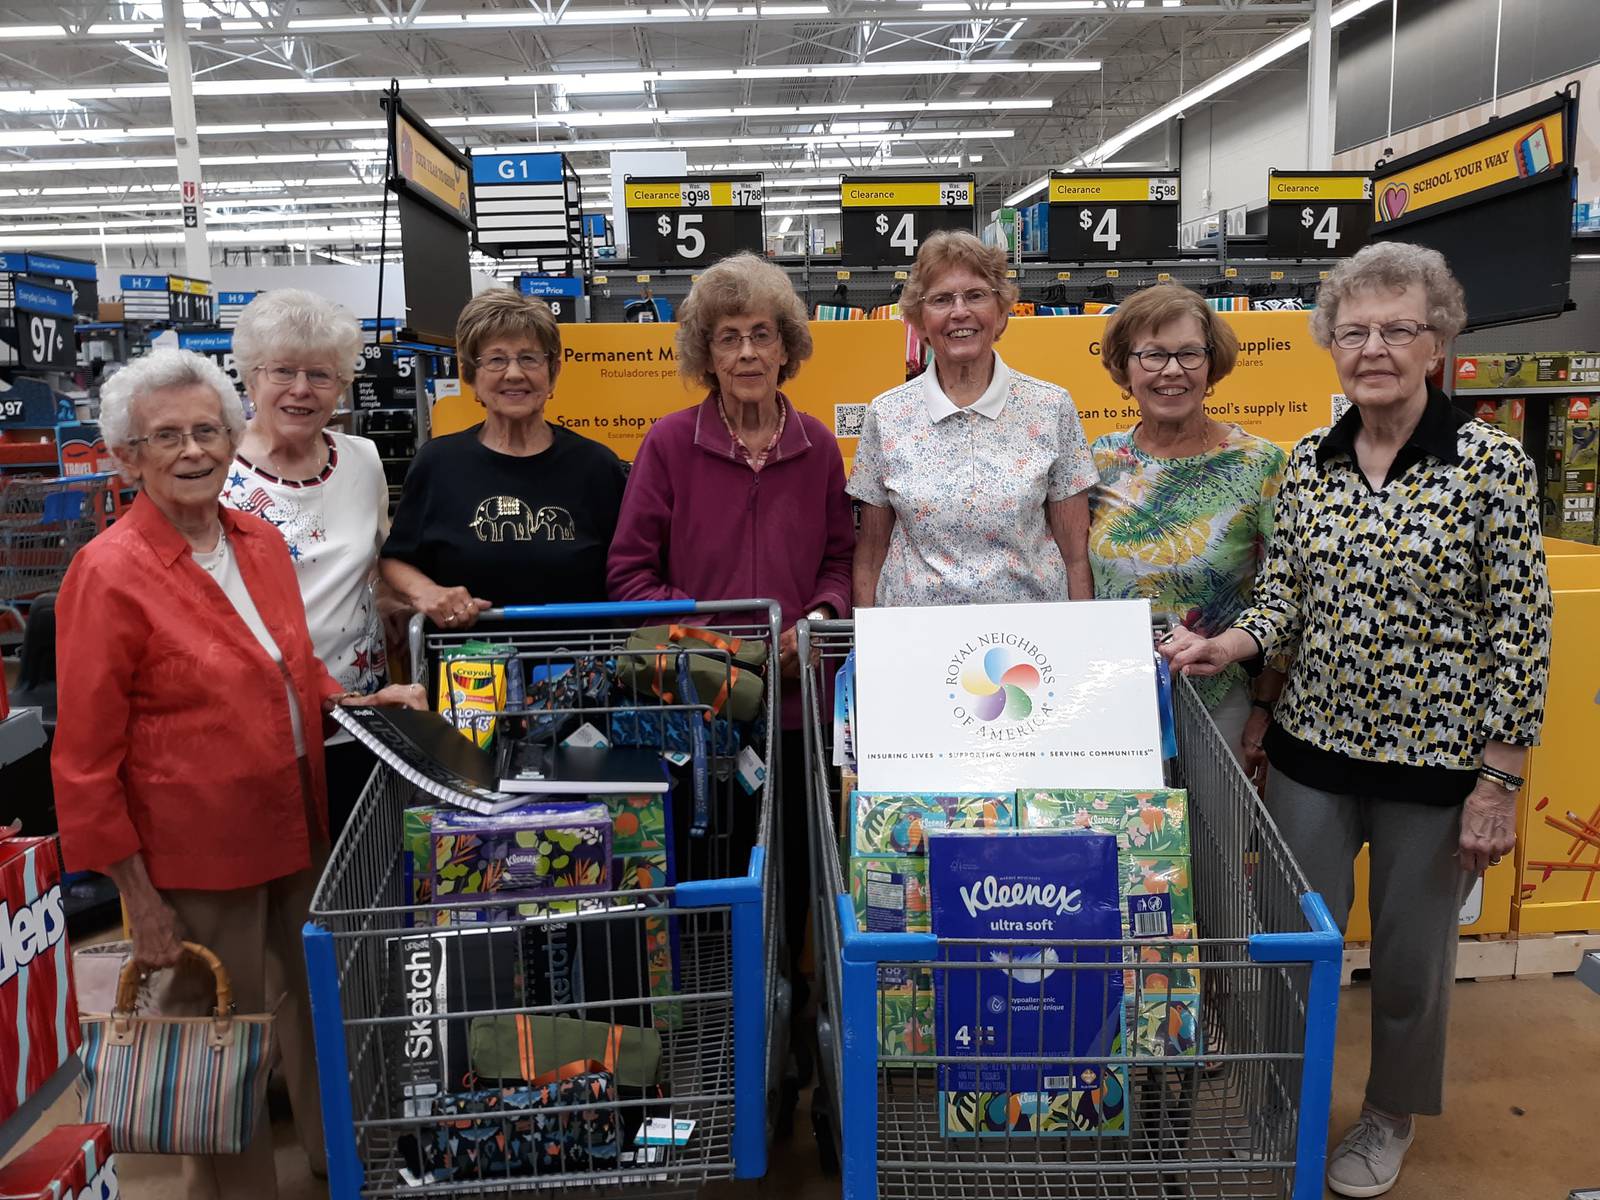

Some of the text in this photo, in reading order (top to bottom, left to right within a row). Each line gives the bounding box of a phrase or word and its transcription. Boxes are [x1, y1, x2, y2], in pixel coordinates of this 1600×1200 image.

[1413, 150, 1509, 194] SCHOOL YOUR WAY
[634, 190, 680, 200] Clearance
[850, 190, 895, 199] Clearance
[1057, 185, 1101, 194] Clearance
[1277, 184, 1320, 193] Clearance
[1238, 337, 1291, 355] upplies
[564, 348, 654, 362] Permanent
[1234, 359, 1264, 367] olares
[600, 368, 660, 378] Rotuladores
[1078, 400, 1308, 419] can to sho hool's supply list
[557, 415, 590, 427] Scan
[595, 416, 609, 427] to
[613, 414, 646, 429] shop
[945, 632, 1056, 685] ROYAL NEIGHBORS
[953, 705, 1053, 741] OF AMERICA
[1087, 814, 1120, 827] Kleenex
[960, 875, 1081, 918] Kleenex
[990, 918, 1054, 931] ultra soft
[404, 951, 433, 1059] Sketch
[1010, 996, 1056, 1004] ypoallerenic
[955, 1025, 972, 1046] 4
